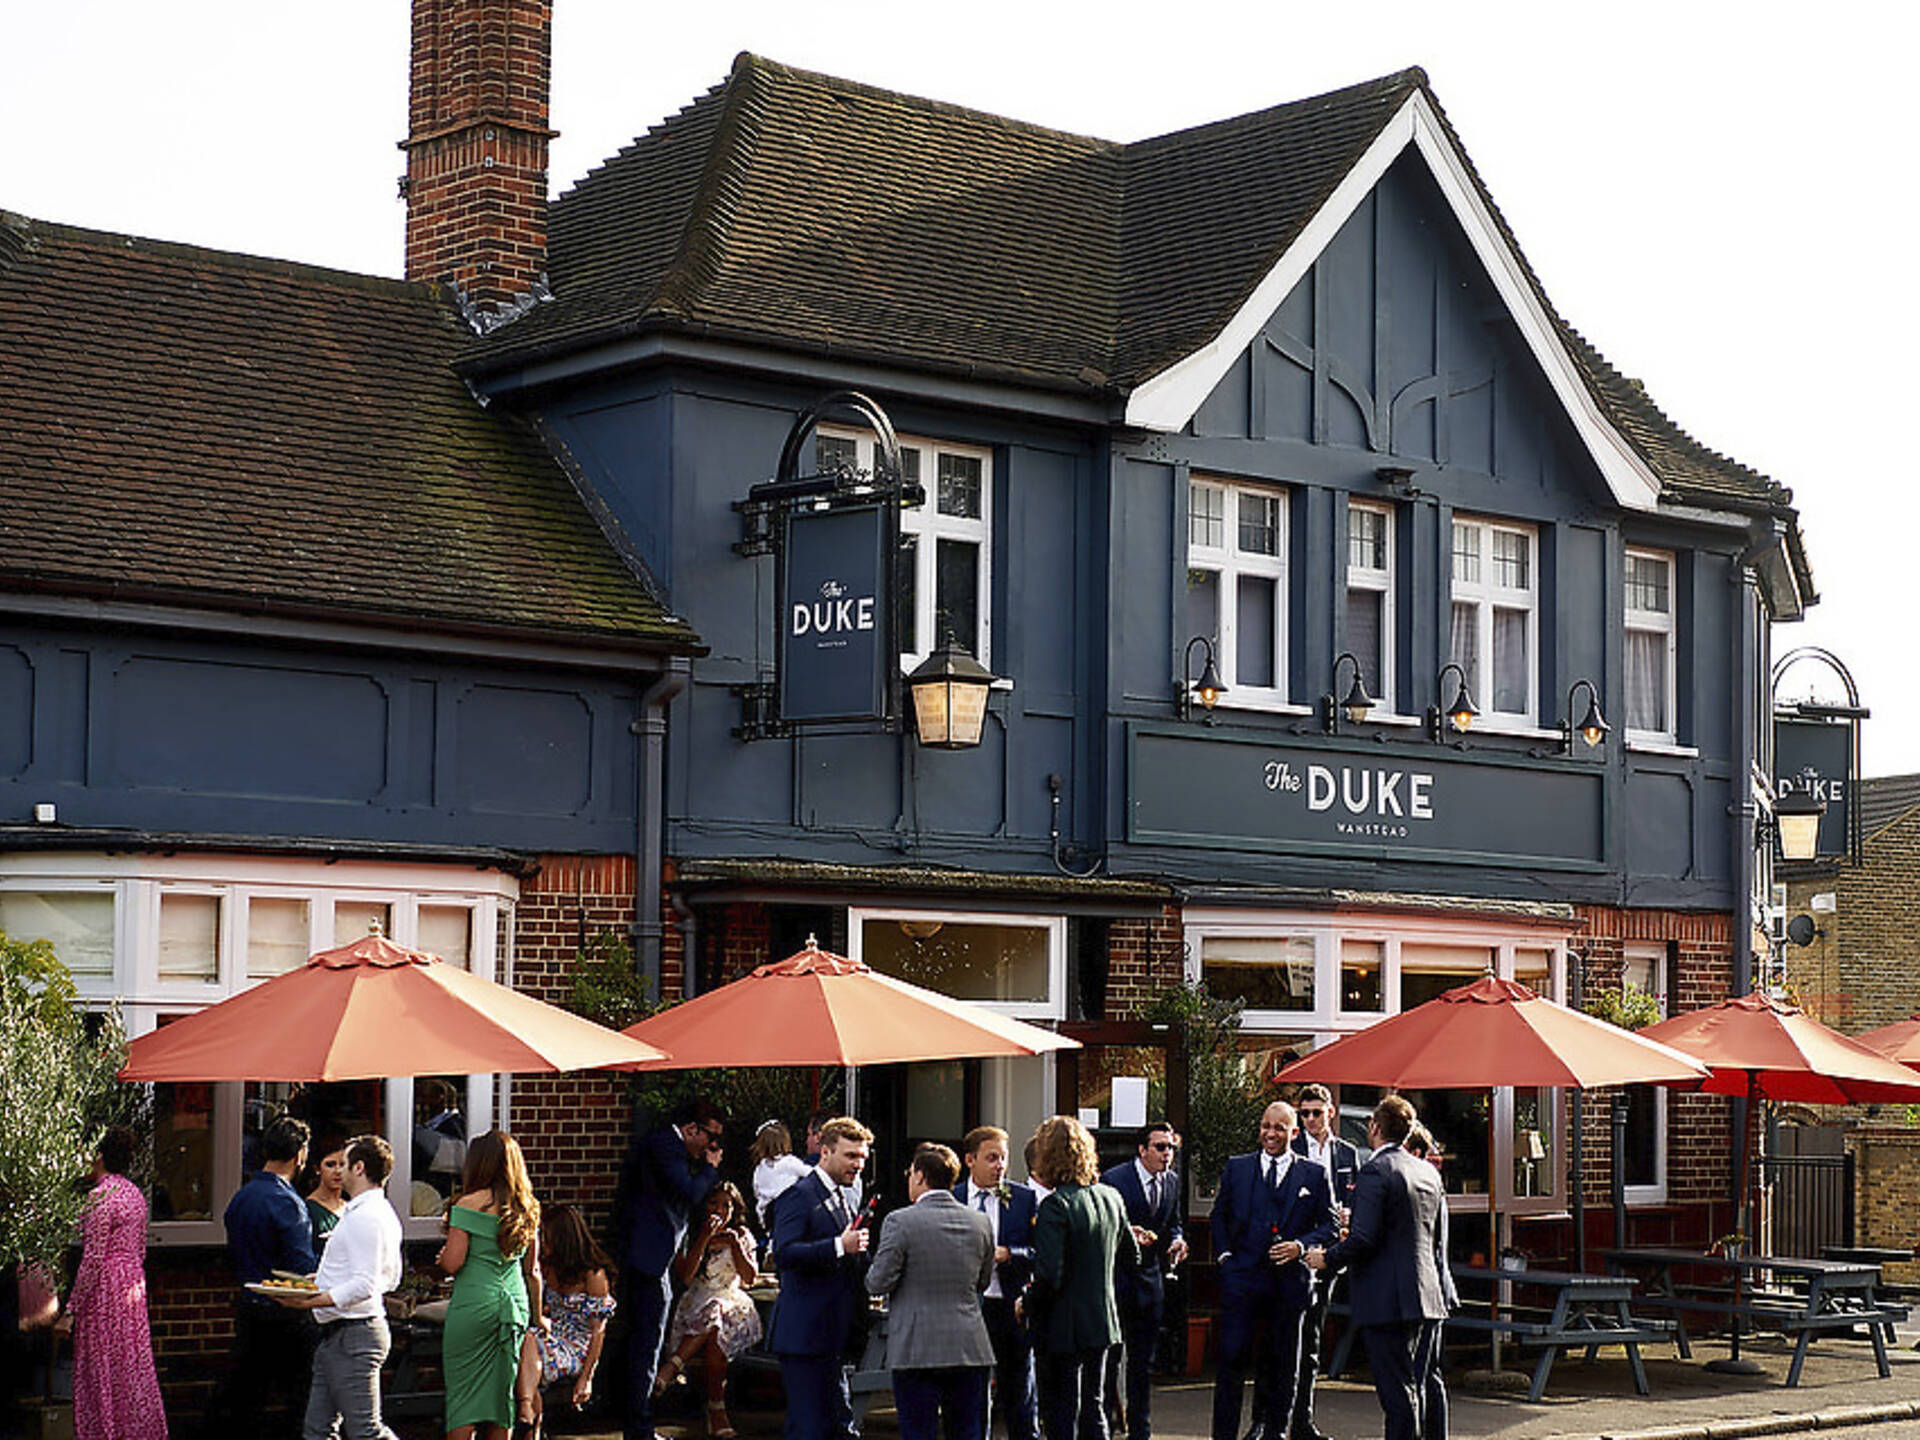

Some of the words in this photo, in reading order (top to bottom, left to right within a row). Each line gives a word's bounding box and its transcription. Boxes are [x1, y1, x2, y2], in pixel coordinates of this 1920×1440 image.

[793, 597, 874, 635] DUKE
[1264, 761, 1302, 792] The
[1308, 765, 1433, 819] DUKE
[1336, 822, 1408, 837] WANSTEAD
